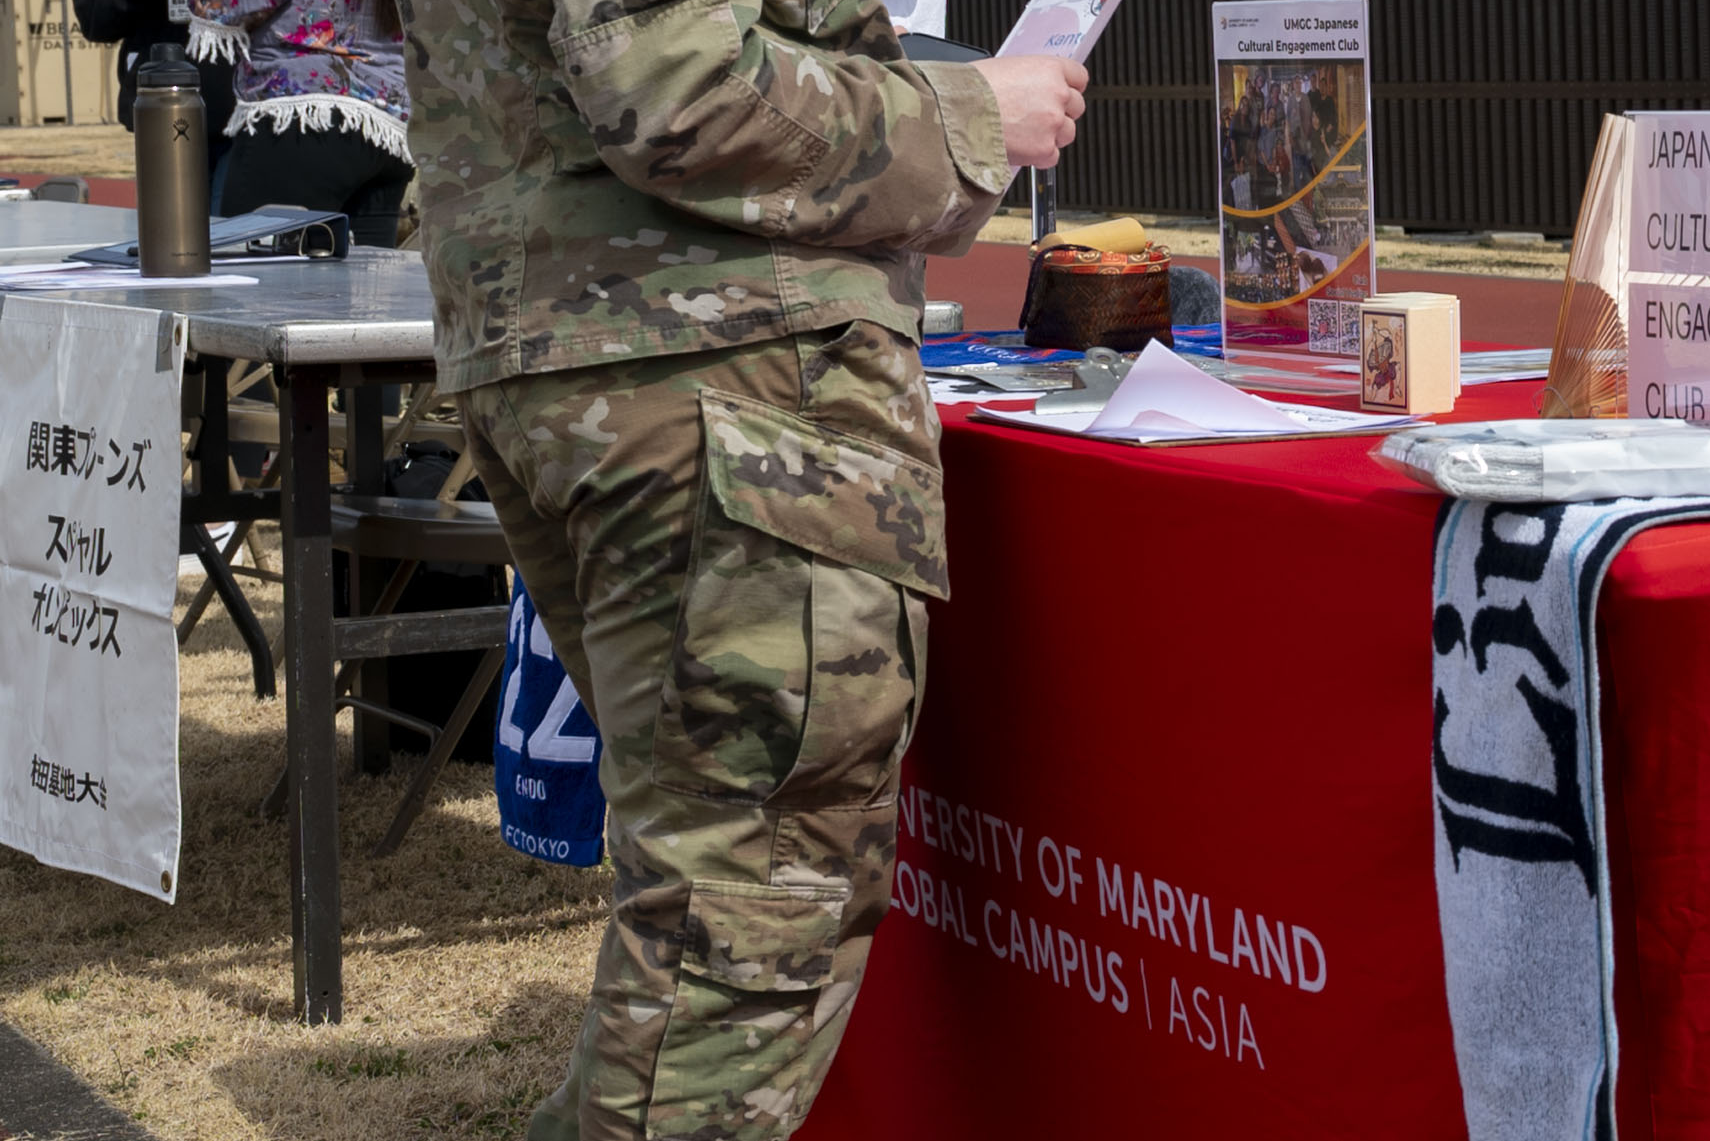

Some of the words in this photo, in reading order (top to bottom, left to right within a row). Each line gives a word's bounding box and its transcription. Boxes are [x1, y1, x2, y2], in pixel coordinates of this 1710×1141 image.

[1284, 19, 1312, 30] UMGC
[1314, 18, 1359, 31] Japanese
[1045, 32, 1084, 47] Kant
[1237, 40, 1274, 53] Cultural
[1276, 39, 1336, 54] Engagement
[1338, 39, 1359, 51] Club
[1645, 382, 1706, 420] CLUB
[515, 774, 546, 800] ENDO
[899, 785, 1024, 883] VERSITY
[1037, 836, 1083, 905] OF
[1096, 857, 1328, 993] MARYLAND
[984, 899, 1130, 1014] CAMPUS
[1168, 976, 1265, 1071] ASIA
